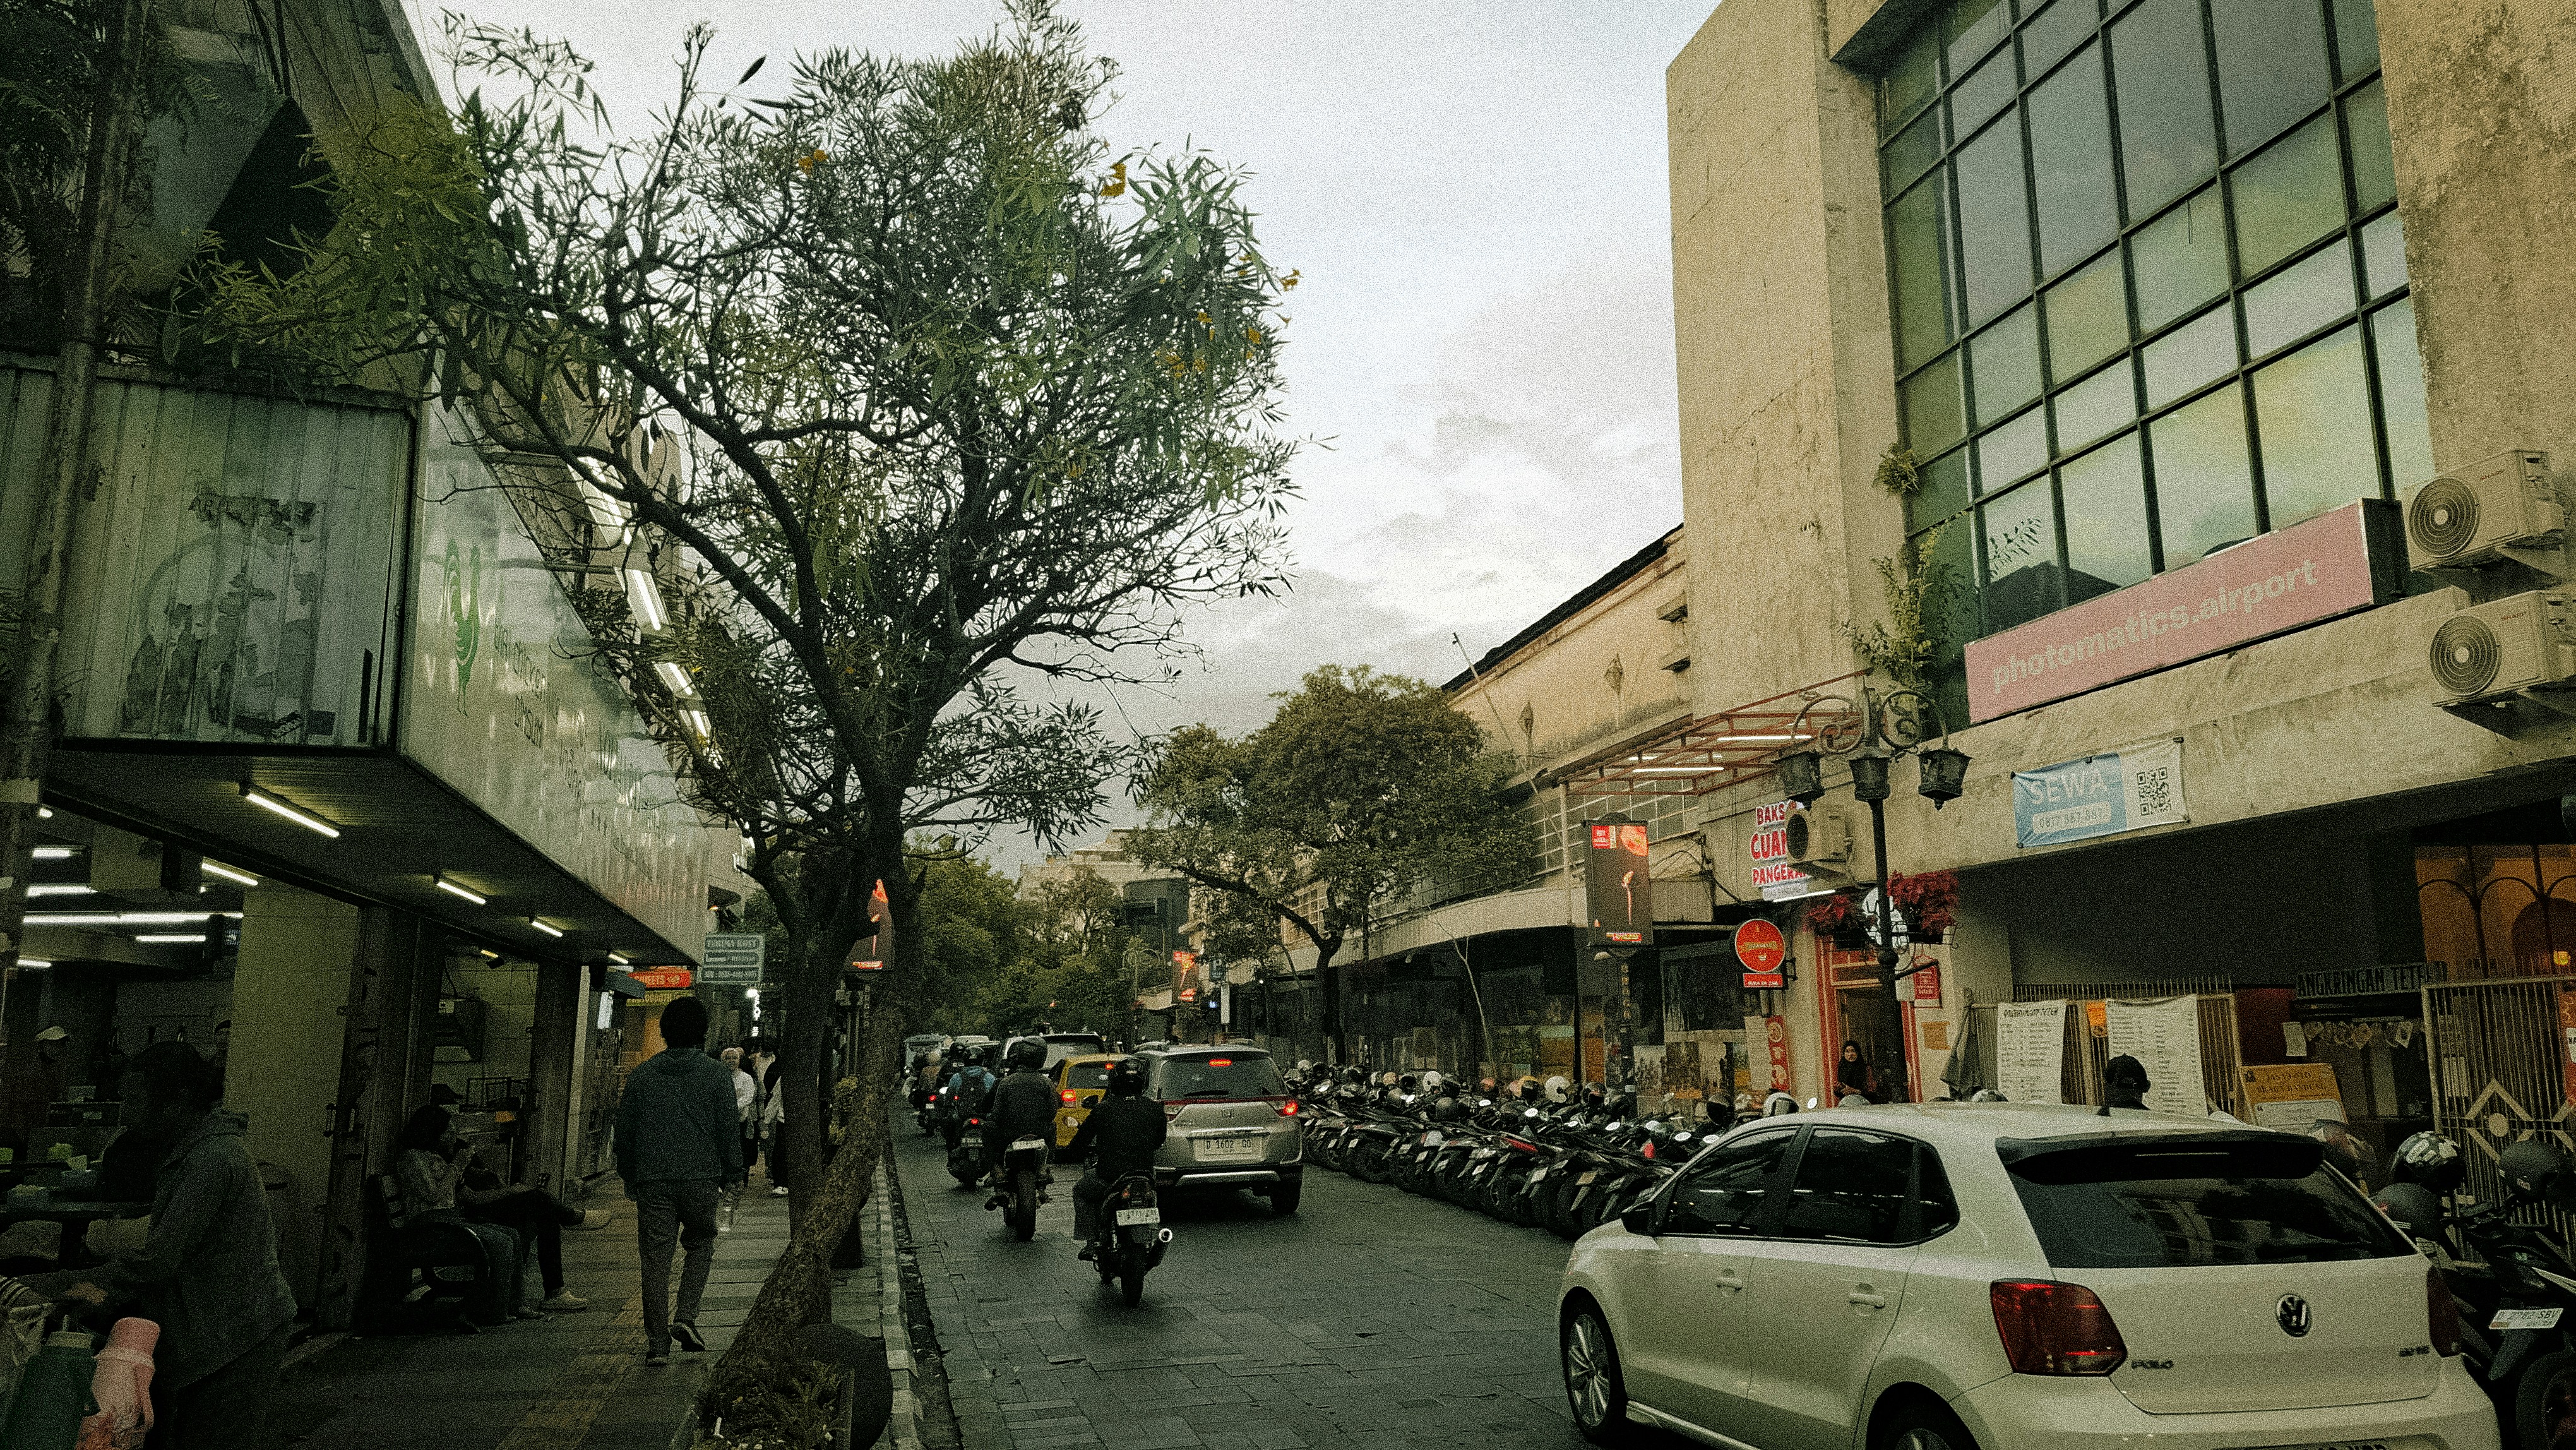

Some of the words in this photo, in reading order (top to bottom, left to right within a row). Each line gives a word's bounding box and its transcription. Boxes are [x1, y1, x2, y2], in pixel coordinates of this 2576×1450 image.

[1991, 558, 2318, 693] photomatics.airport
[2030, 769, 2108, 805] SEWA
[2298, 968, 2385, 997] ANGKRINGAN
[1205, 1141, 1211, 1149] D
[2132, 1360, 2173, 1370] POLO
